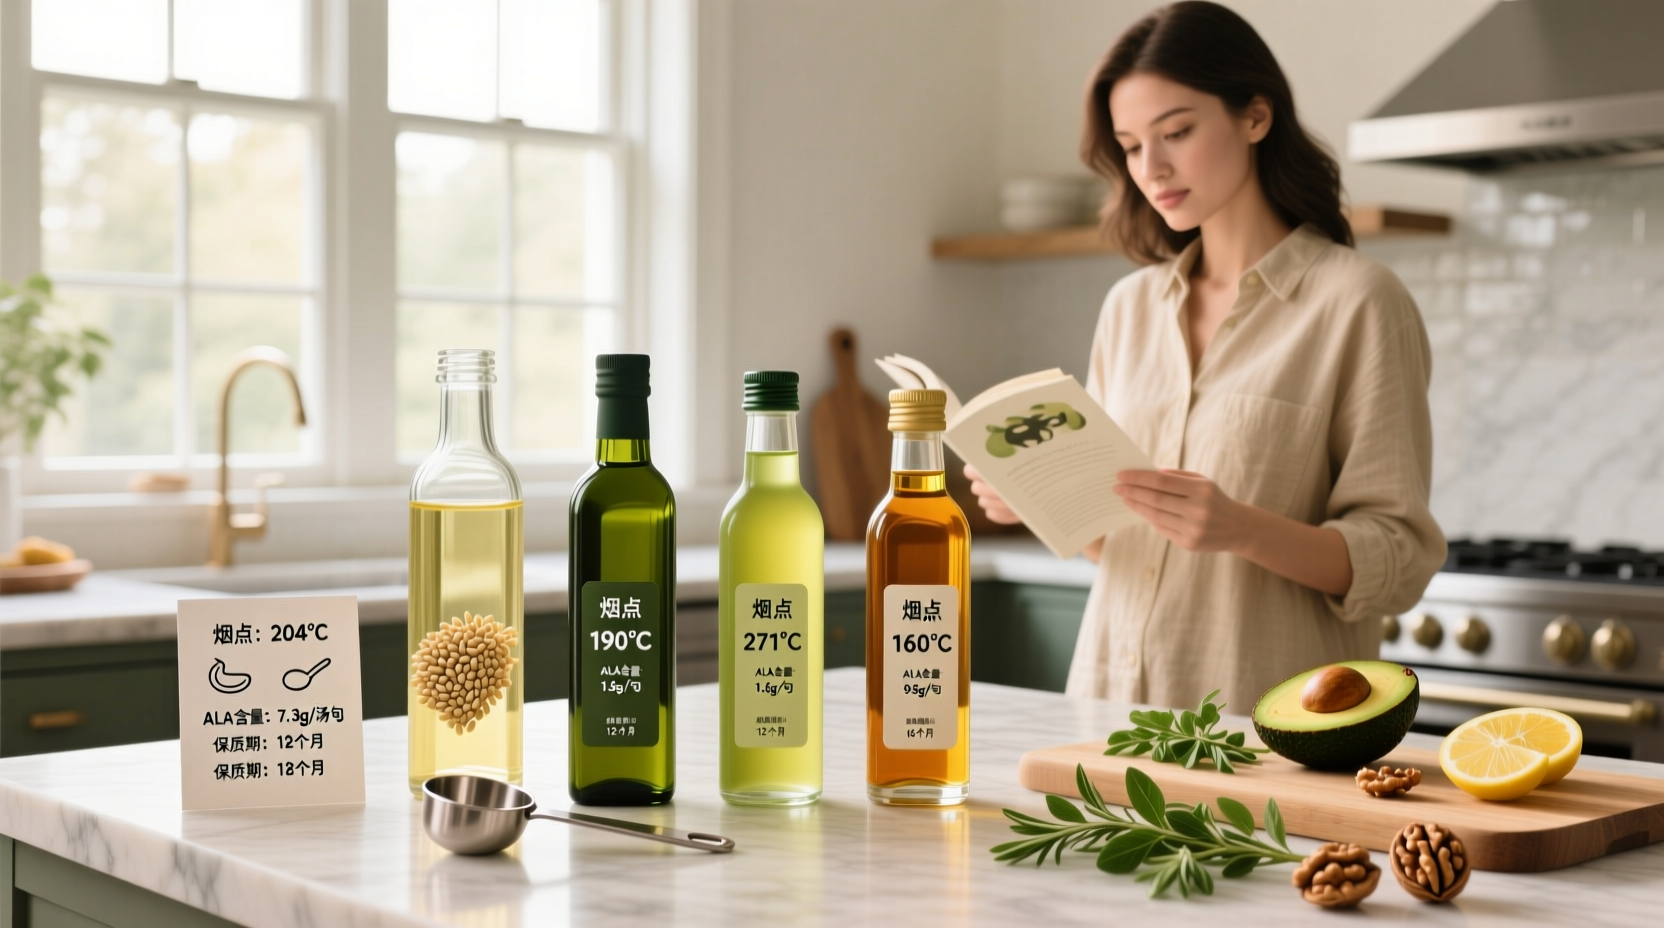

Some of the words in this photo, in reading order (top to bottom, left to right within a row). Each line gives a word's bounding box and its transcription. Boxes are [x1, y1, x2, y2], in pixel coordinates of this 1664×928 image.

[600, 597, 641, 619] 烟点
[752, 598, 792, 620] 烟点
[902, 599, 942, 622] 烟点
[590, 630, 652, 651] 190°C
[744, 631, 801, 651] 271°C
[893, 633, 952, 653] 160°C
